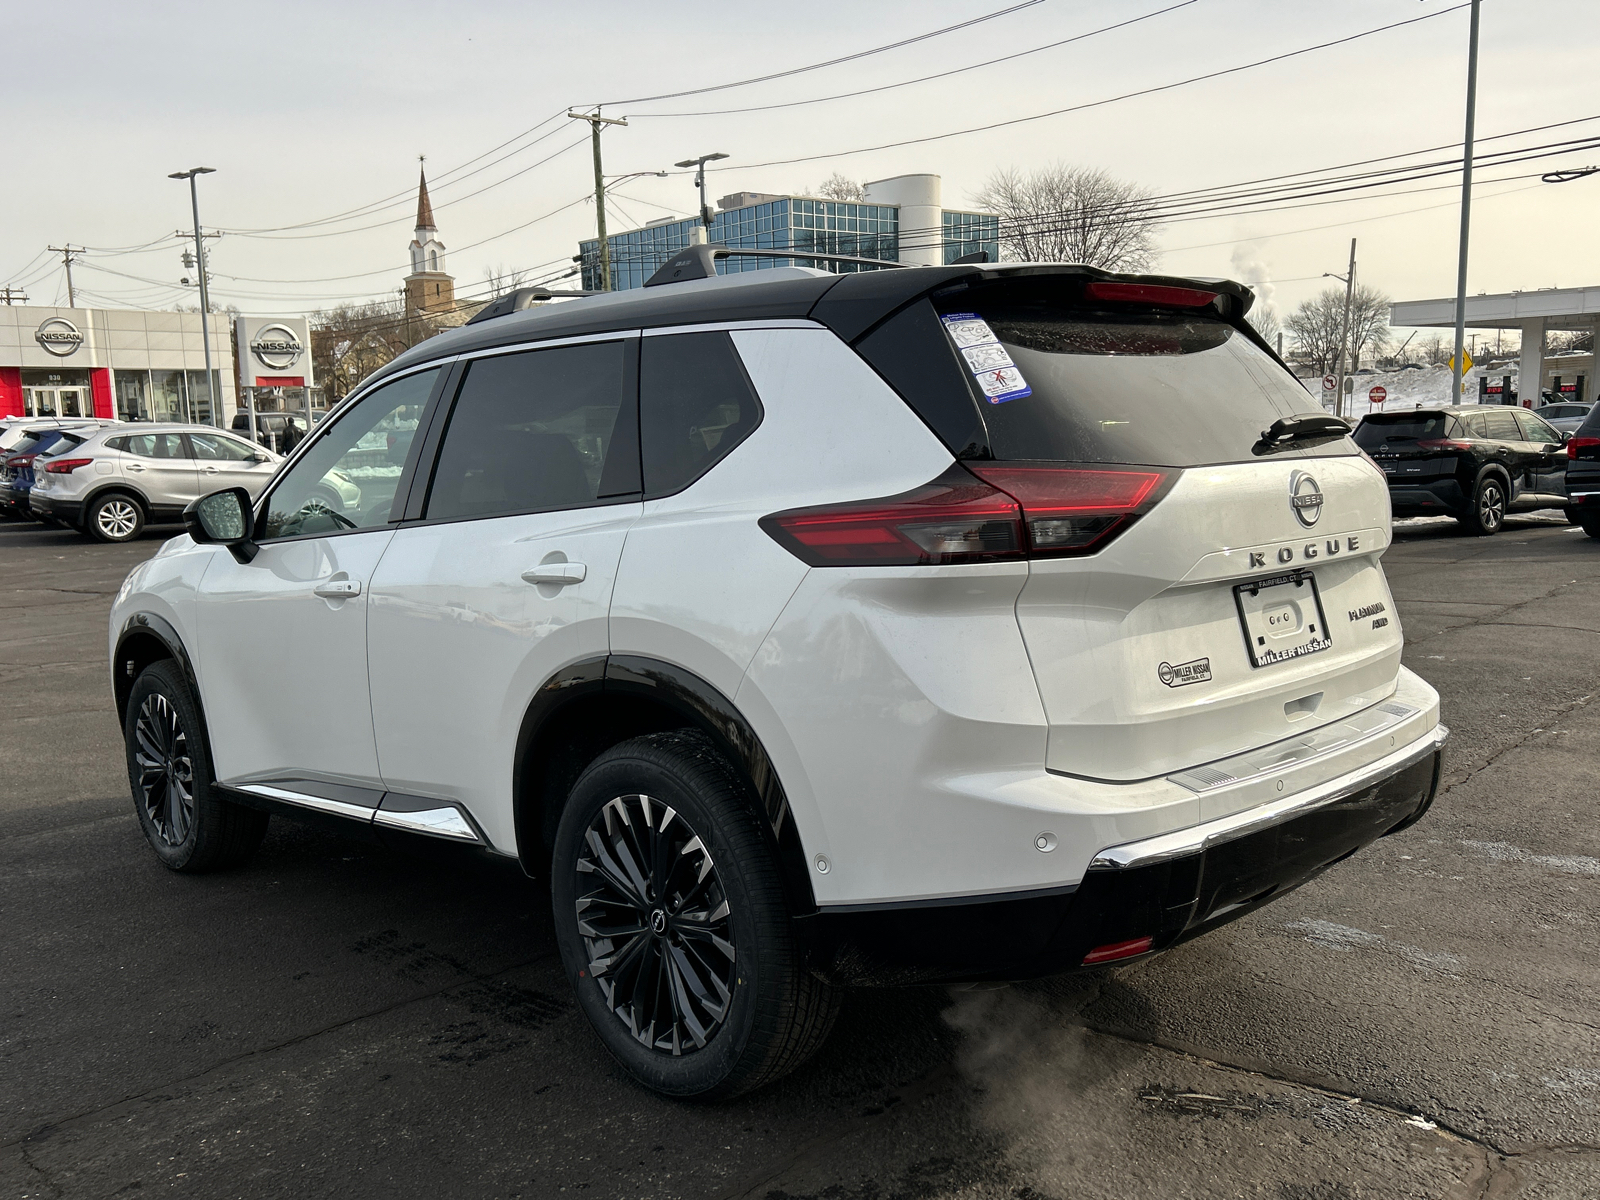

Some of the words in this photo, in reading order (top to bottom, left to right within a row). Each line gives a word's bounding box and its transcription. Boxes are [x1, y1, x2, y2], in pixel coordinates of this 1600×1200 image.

[1249, 536, 1360, 568] ROGUE
[1372, 617, 1388, 630] AWD
[1257, 649, 1296, 666] MILLER
[1297, 638, 1332, 655] NISSAN
[1174, 666, 1192, 678] MILLER
[1192, 663, 1210, 675] NISSAN
